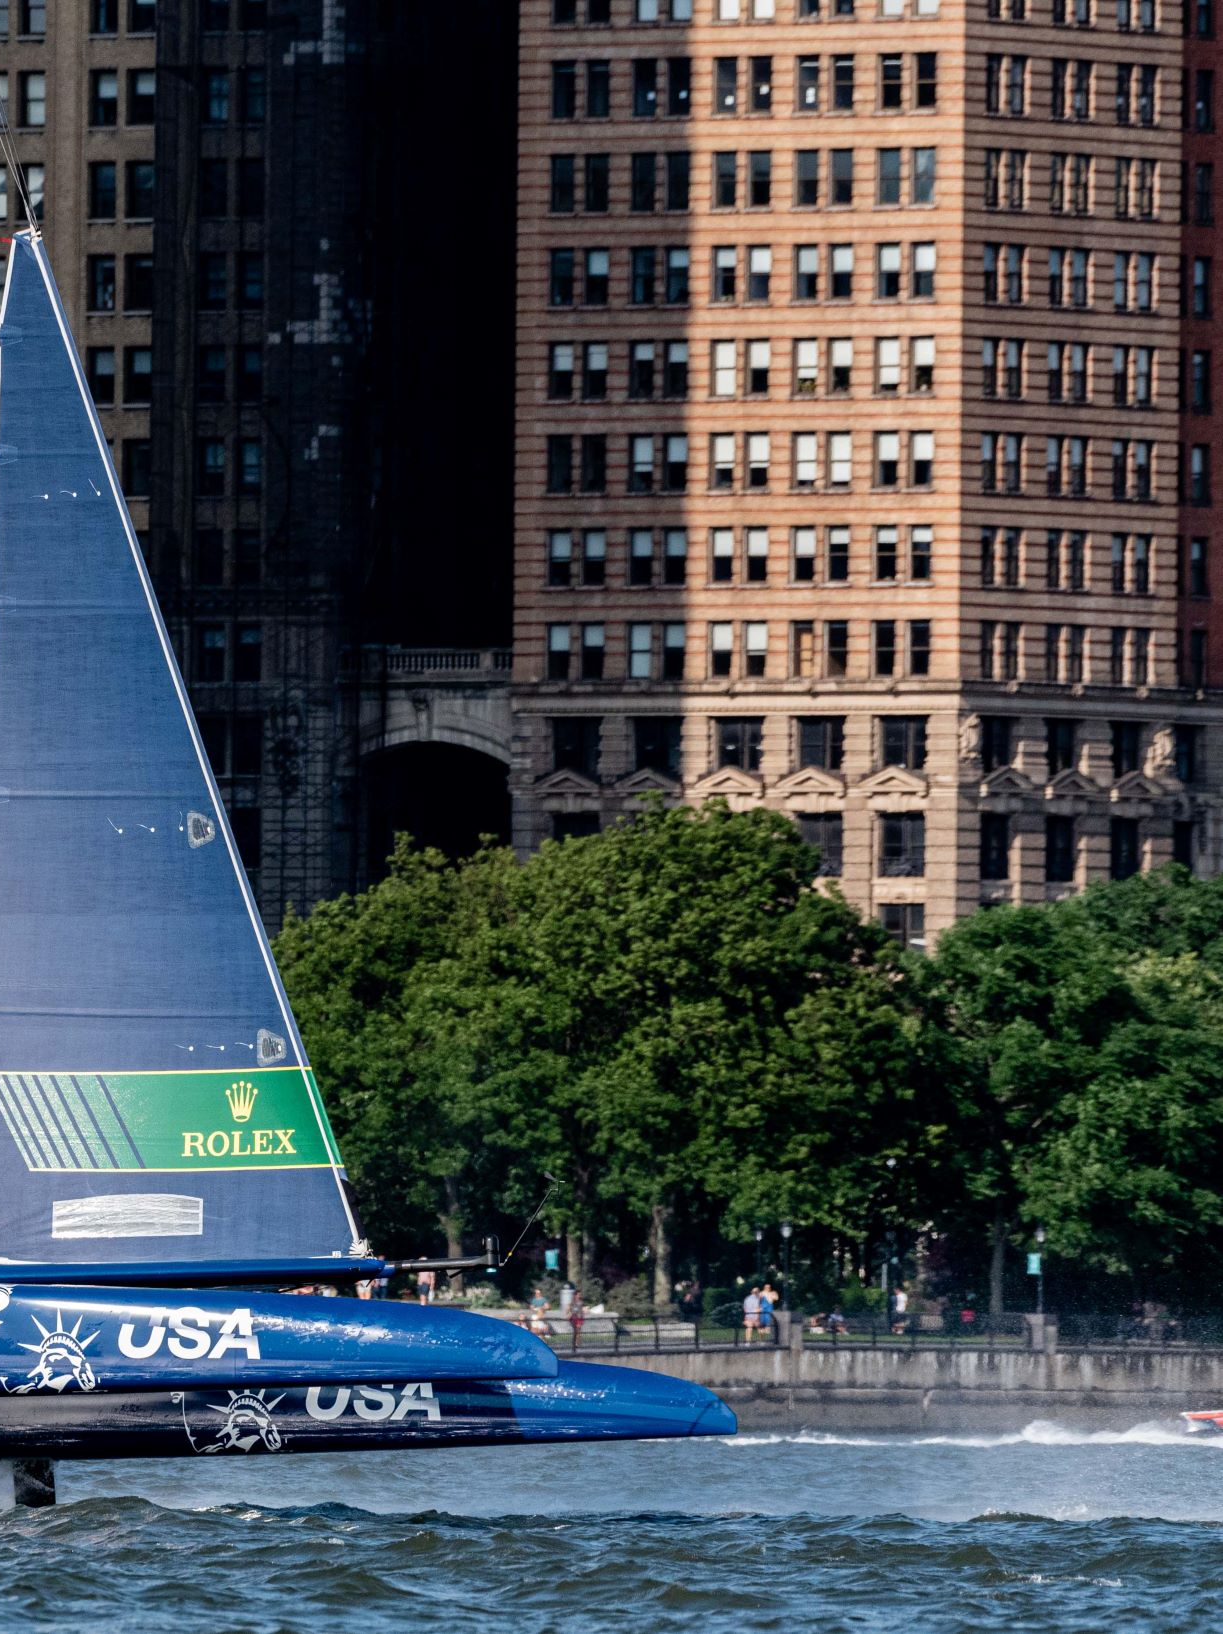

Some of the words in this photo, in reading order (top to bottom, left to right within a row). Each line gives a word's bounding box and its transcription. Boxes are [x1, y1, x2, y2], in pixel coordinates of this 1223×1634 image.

[181, 1129, 297, 1157] ROLEX
[117, 1306, 261, 1360] USA
[305, 1382, 441, 1421] USA
